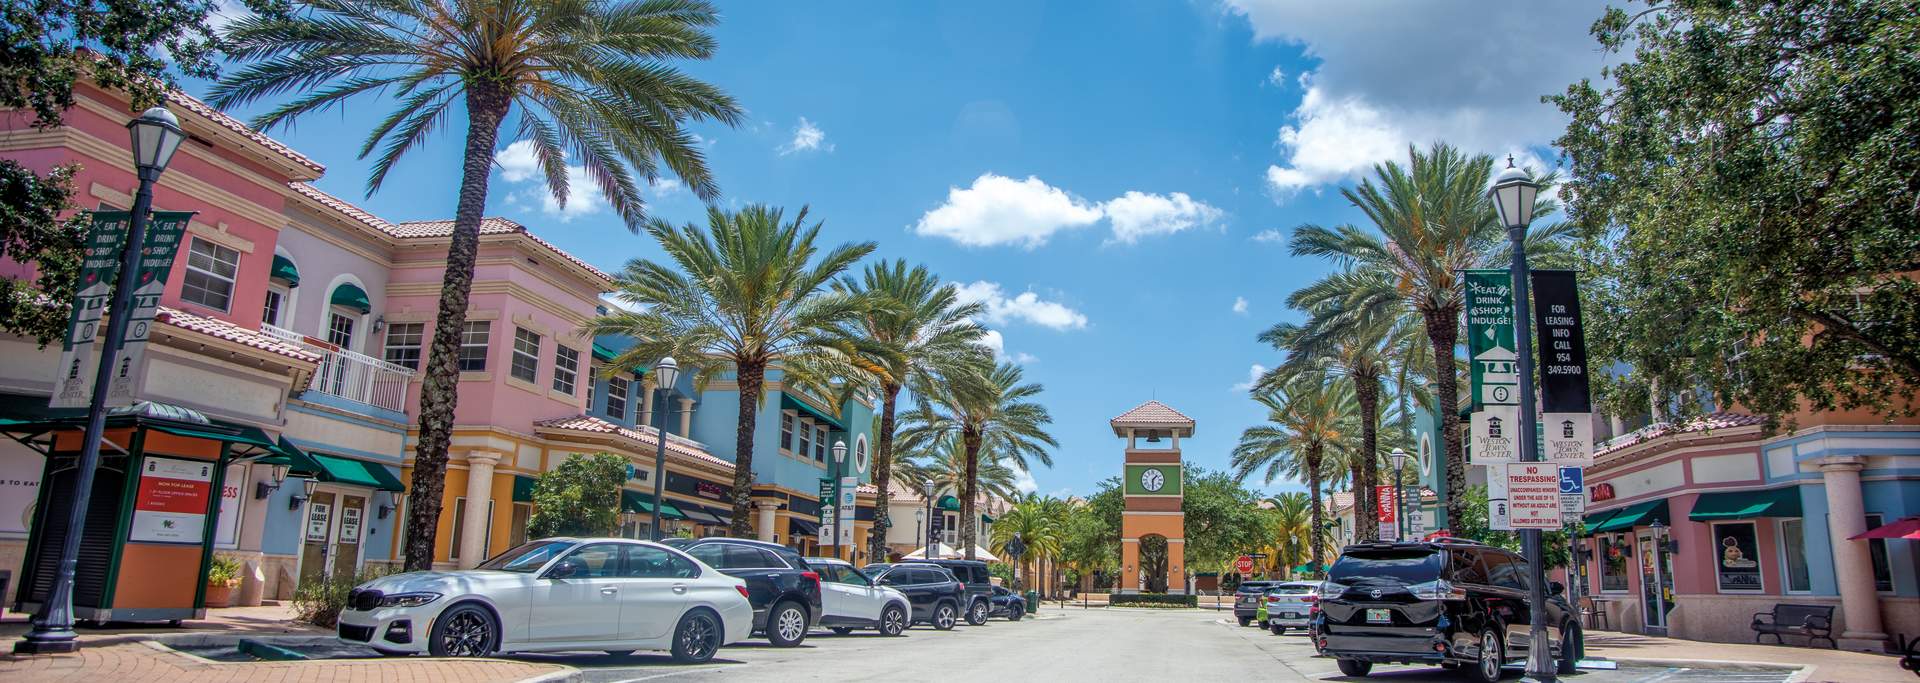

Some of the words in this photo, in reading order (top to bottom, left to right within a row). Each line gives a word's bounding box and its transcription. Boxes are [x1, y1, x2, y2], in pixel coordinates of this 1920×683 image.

[104, 222, 117, 231] EAT
[163, 222, 177, 231] EAT
[1475, 296, 1505, 305] DRINK.
[1551, 304, 1566, 314] FOR
[1471, 317, 1511, 325] INDULGE!
[1544, 316, 1575, 326] LEASING
[1552, 328, 1570, 338] INFO
[1553, 340, 1572, 350] CALL
[1556, 353, 1571, 362] 954
[1547, 365, 1582, 375] 349.5900
[1477, 435, 1513, 445] WESTON
[1550, 440, 1585, 448] WESTON
[1483, 444, 1507, 452] TOWN
[1479, 450, 1513, 458] CENTER
[1526, 466, 1538, 475] NO
[1510, 475, 1557, 483] TRESPASSING
[1380, 487, 1392, 513] PANNA
[315, 504, 326, 513] FOR
[347, 509, 357, 517] FOR
[311, 513, 328, 522] LEASE
[343, 517, 359, 526] LEASE
[1237, 560, 1252, 568] STOP
